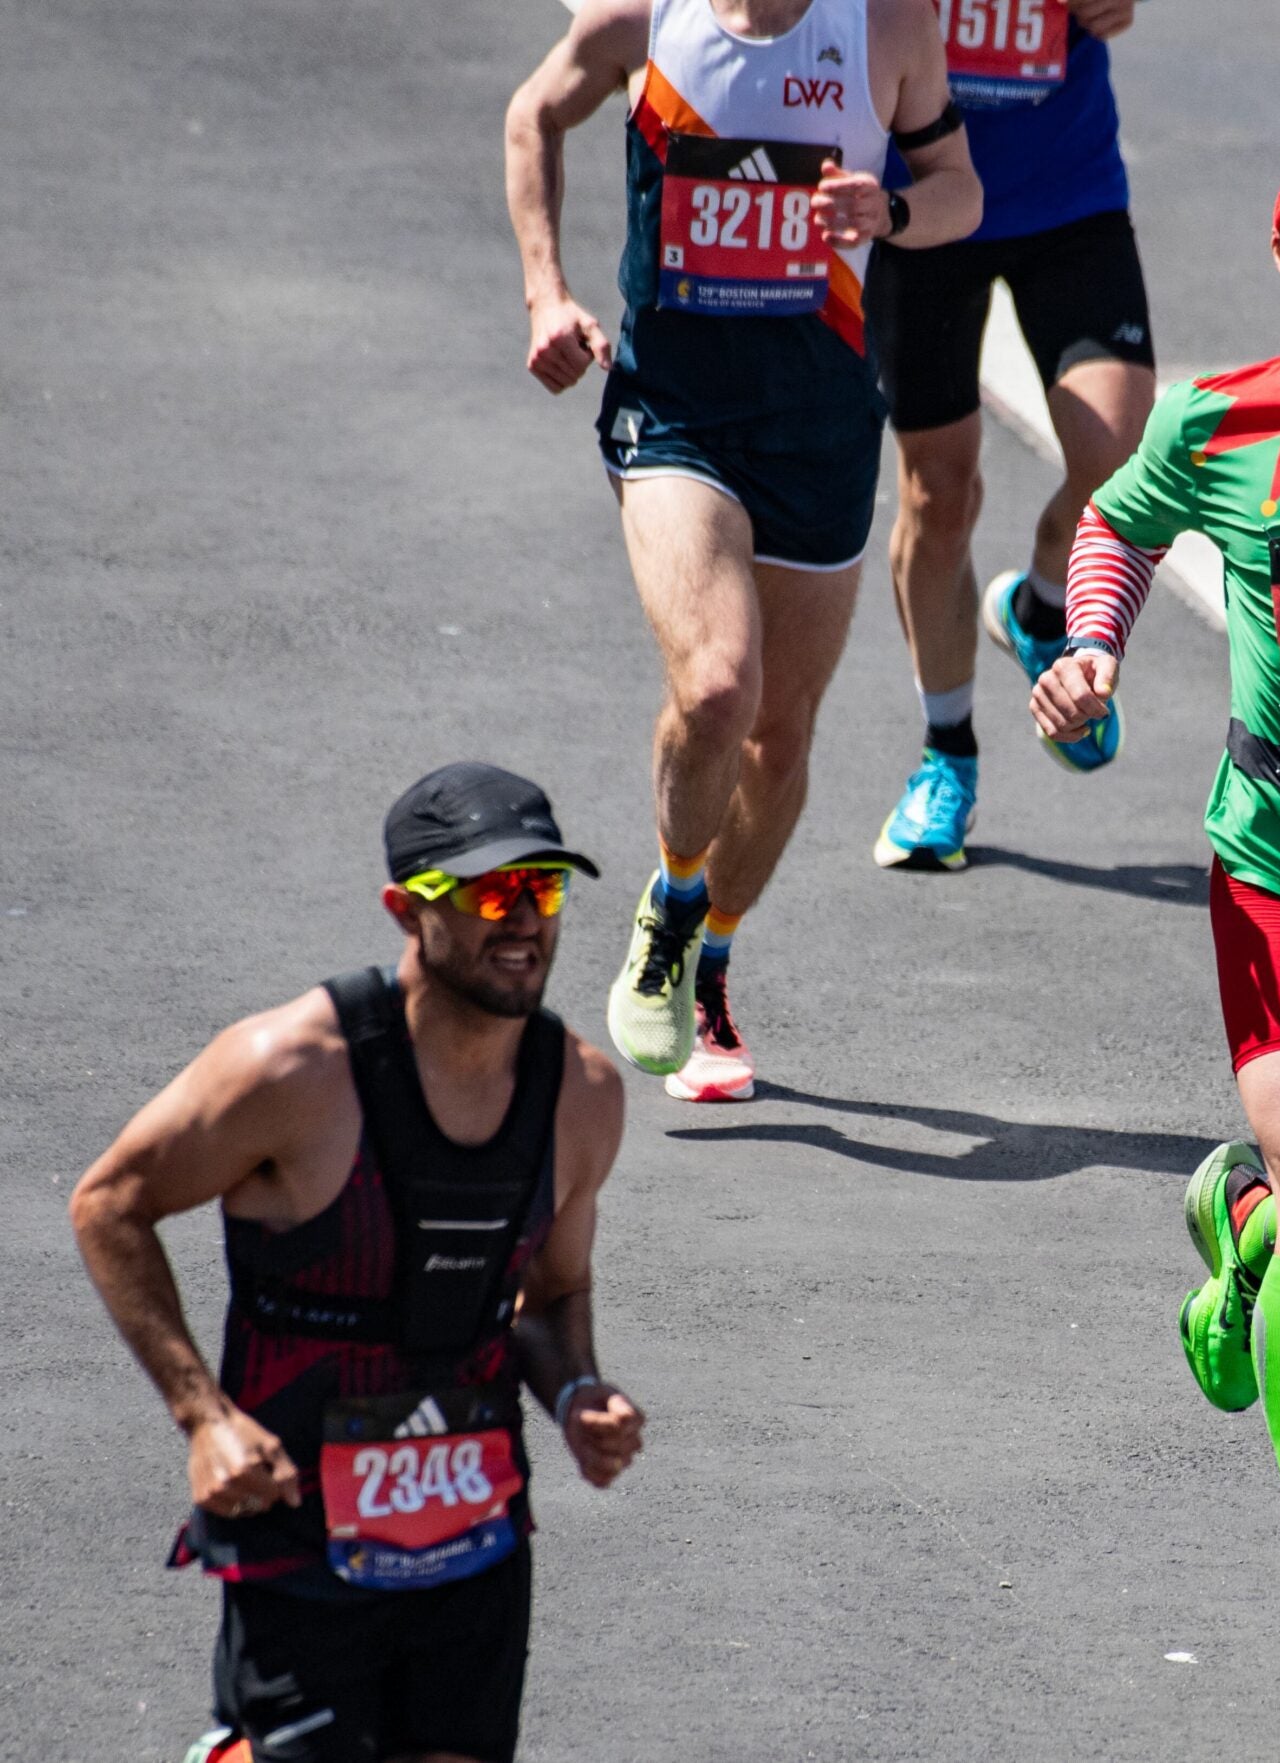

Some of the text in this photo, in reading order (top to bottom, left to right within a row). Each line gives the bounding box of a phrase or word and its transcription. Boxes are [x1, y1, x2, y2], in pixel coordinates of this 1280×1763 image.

[782, 76, 844, 111] DWR
[689, 186, 810, 251] 3218
[669, 251, 678, 262] 3
[719, 287, 758, 299] BOSTON
[760, 288, 814, 299] MARATHON
[353, 1439, 493, 1518] 2348
